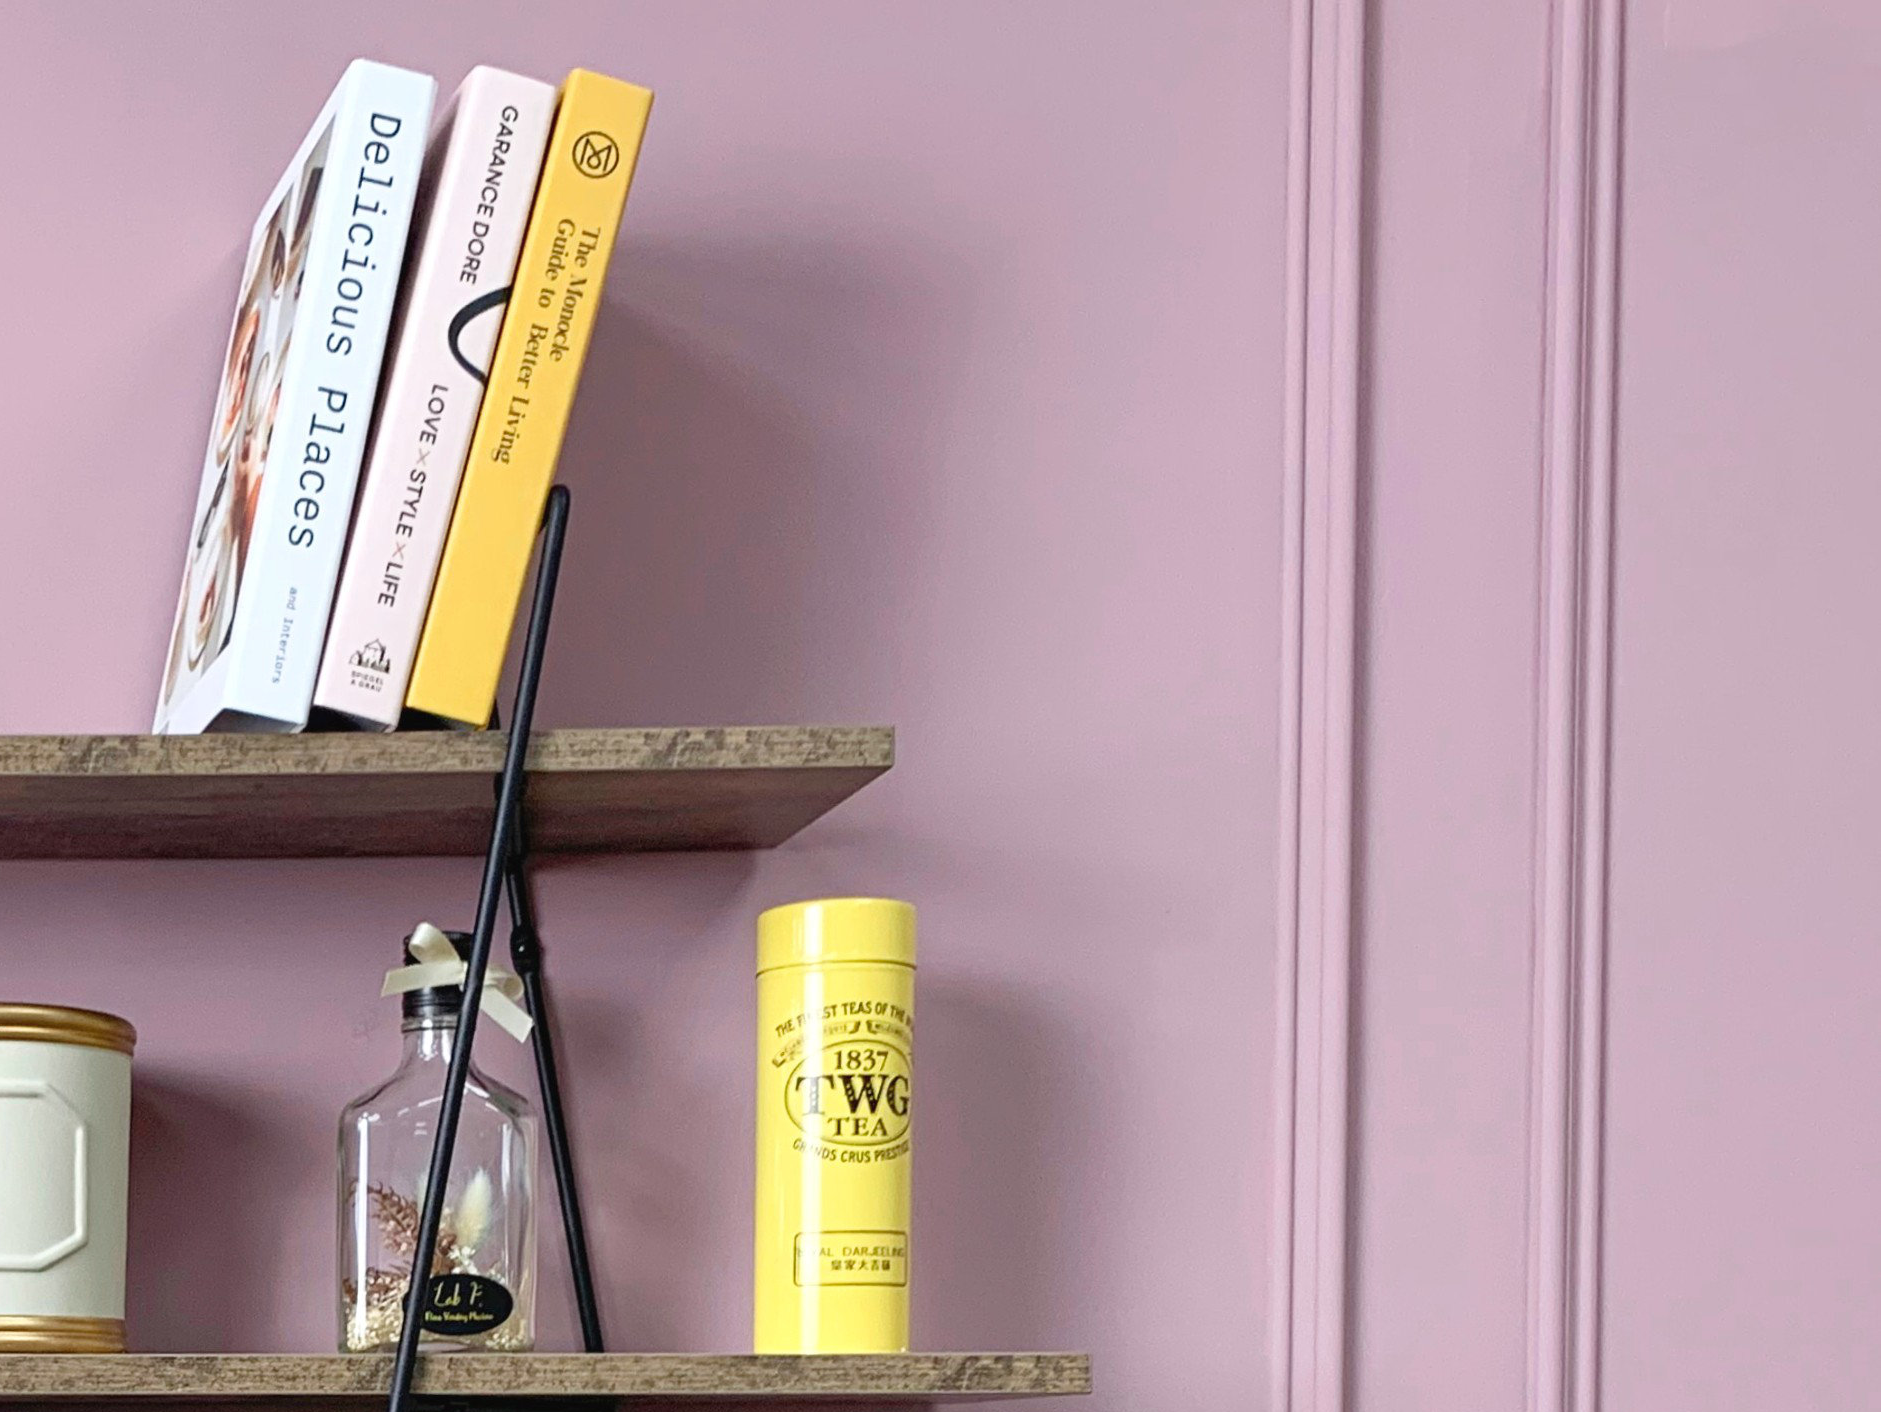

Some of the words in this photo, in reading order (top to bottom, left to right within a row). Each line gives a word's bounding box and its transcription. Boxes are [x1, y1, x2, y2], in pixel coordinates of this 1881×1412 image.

[476, 105, 519, 219] GARANCE
[325, 112, 403, 357] Delicious
[459, 220, 490, 285] DORE
[544, 217, 577, 281] Guide
[574, 226, 602, 269] The
[538, 287, 556, 309] to
[548, 273, 589, 363] Monocle
[516, 323, 549, 390] Better
[418, 383, 449, 446] LOVE
[490, 395, 531, 465] Living
[287, 385, 349, 550] Places
[394, 468, 427, 539] STYLE
[285, 586, 298, 611] and
[376, 561, 404, 609] LIFE
[271, 616, 295, 685] Interiors
[774, 1018, 796, 1038] THE
[841, 1001, 873, 1017] TEAS
[874, 1001, 889, 1016] OF
[833, 1049, 890, 1072] 1837
[794, 1073, 911, 1118] TWG
[826, 1116, 889, 1137] TEA
[839, 1150, 872, 1164] CRUS
